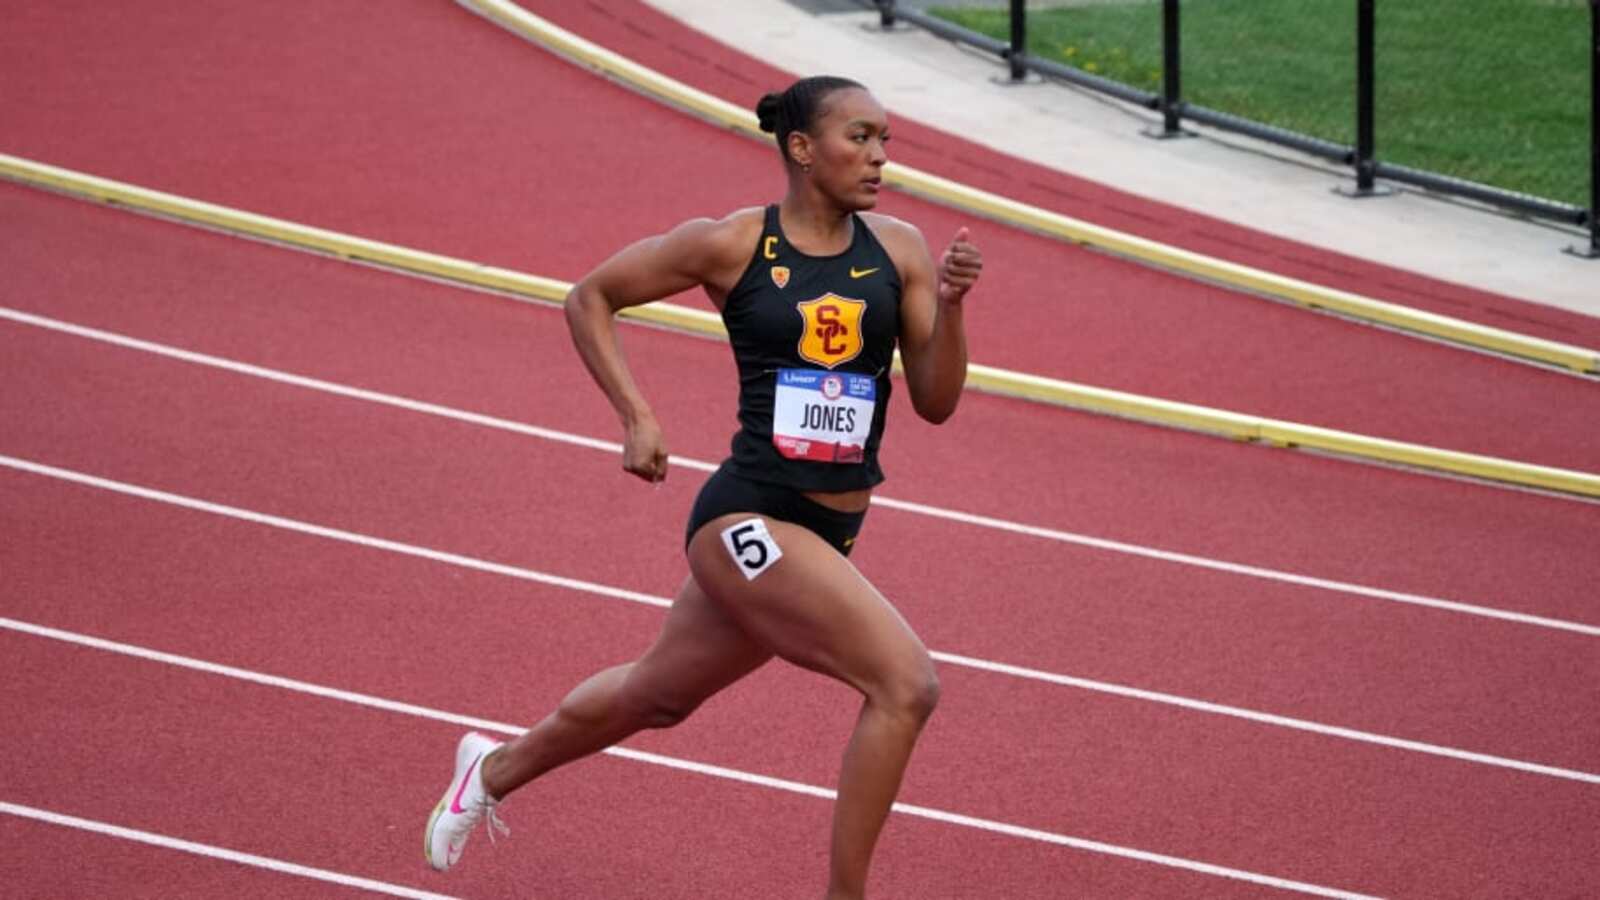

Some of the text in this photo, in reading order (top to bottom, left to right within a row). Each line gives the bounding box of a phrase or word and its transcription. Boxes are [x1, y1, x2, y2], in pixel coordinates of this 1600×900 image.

[764, 236, 778, 259] C
[800, 403, 856, 433] JONES
[731, 524, 767, 569] 5
